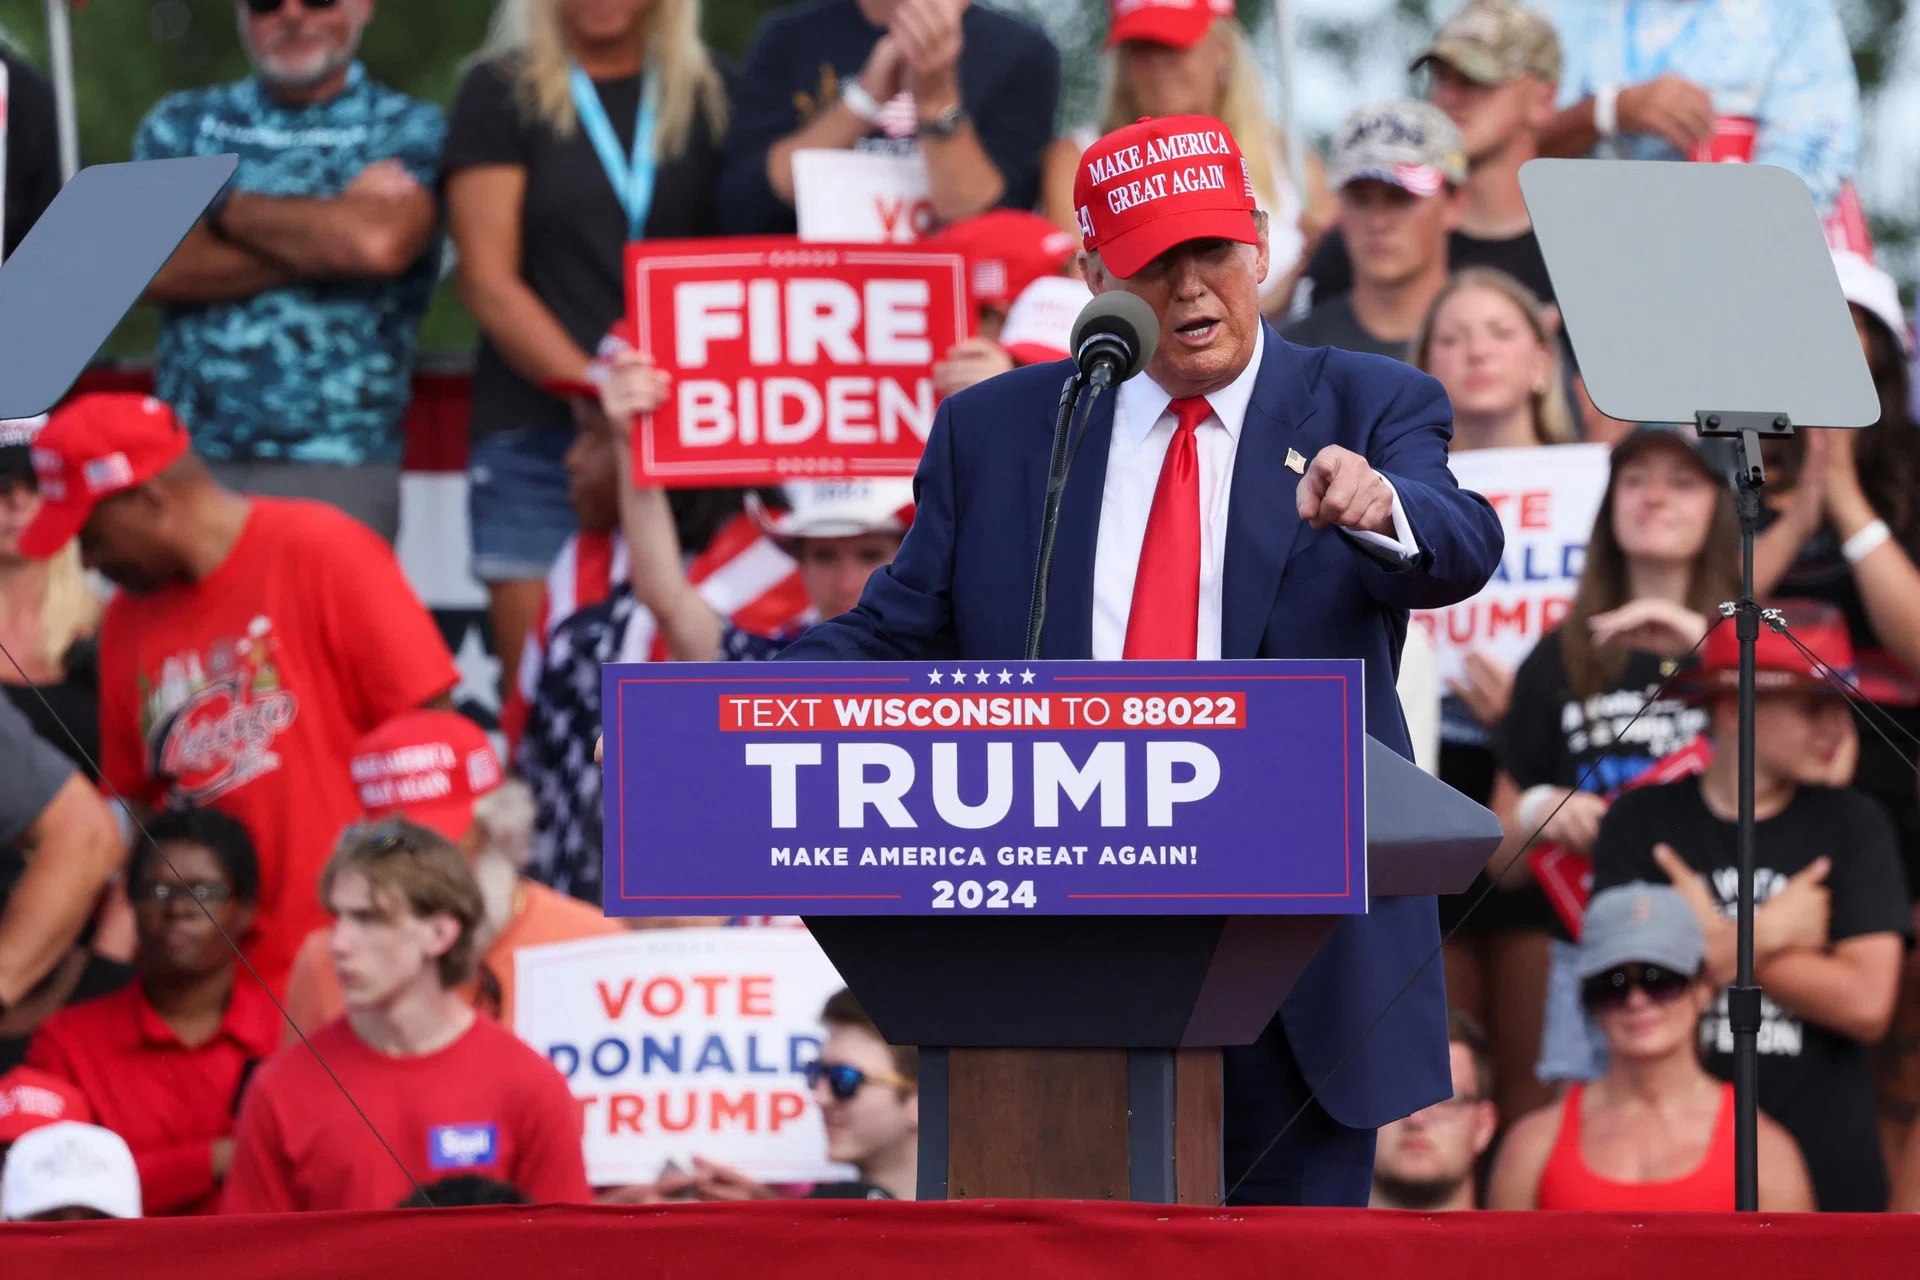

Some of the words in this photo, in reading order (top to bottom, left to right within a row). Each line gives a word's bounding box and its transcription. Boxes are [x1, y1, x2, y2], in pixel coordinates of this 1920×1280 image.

[1088, 145, 1144, 187] MAKE
[1146, 131, 1231, 166] AMERICA
[1107, 173, 1168, 215] GREAT
[1172, 165, 1226, 195] AGAIN
[873, 196, 938, 243] VO
[674, 279, 933, 368] FIRE
[677, 376, 937, 447] BIDEN
[730, 699, 821, 726] TEXT
[833, 698, 1050, 726] WISCONSIN
[1062, 698, 1110, 726] TO
[1122, 697, 1236, 726] 88022
[745, 741, 1221, 830] TRUMP
[771, 847, 849, 866] MAKE
[859, 846, 987, 866] AMERICA
[997, 846, 1089, 865] GREAT
[1098, 845, 1197, 865] AGAIN!
[931, 880, 1037, 909] 2024
[596, 975, 774, 1021] VOTE
[550, 1033, 823, 1079] DONALD
[574, 1090, 807, 1136] TRUMP
